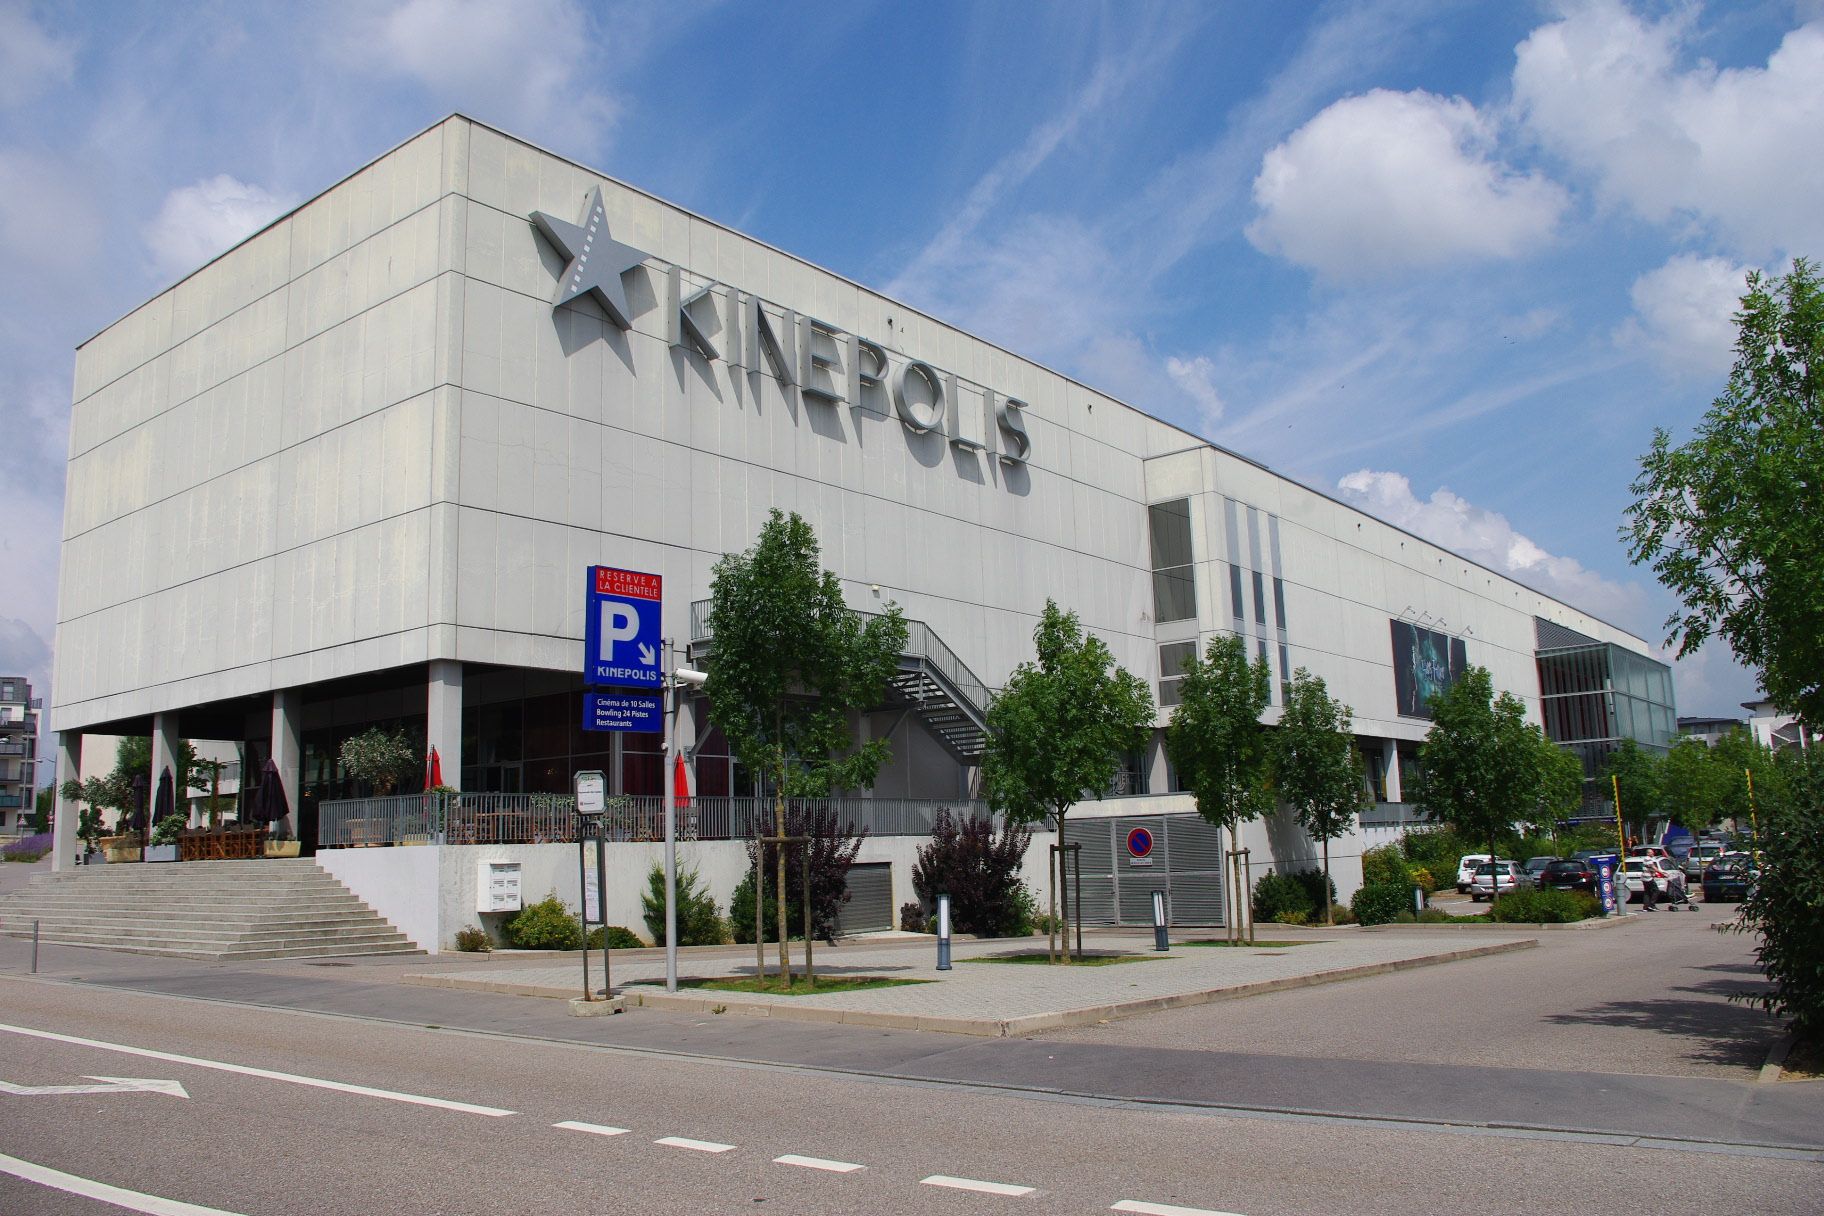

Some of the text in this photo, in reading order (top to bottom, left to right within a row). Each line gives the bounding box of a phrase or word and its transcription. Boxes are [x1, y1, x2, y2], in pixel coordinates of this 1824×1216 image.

[668, 264, 1031, 463] KINEPOLIS
[600, 570, 658, 588] RESERVE A
[599, 580, 658, 598] LA CLIENTELE
[600, 600, 640, 662] P
[597, 665, 657, 681] KINEPOLIS
[597, 698, 656, 709] Cinéma de 10 Salles
[596, 708, 649, 719] Bowling 24 Pistes
[596, 718, 633, 727] Restaurants
